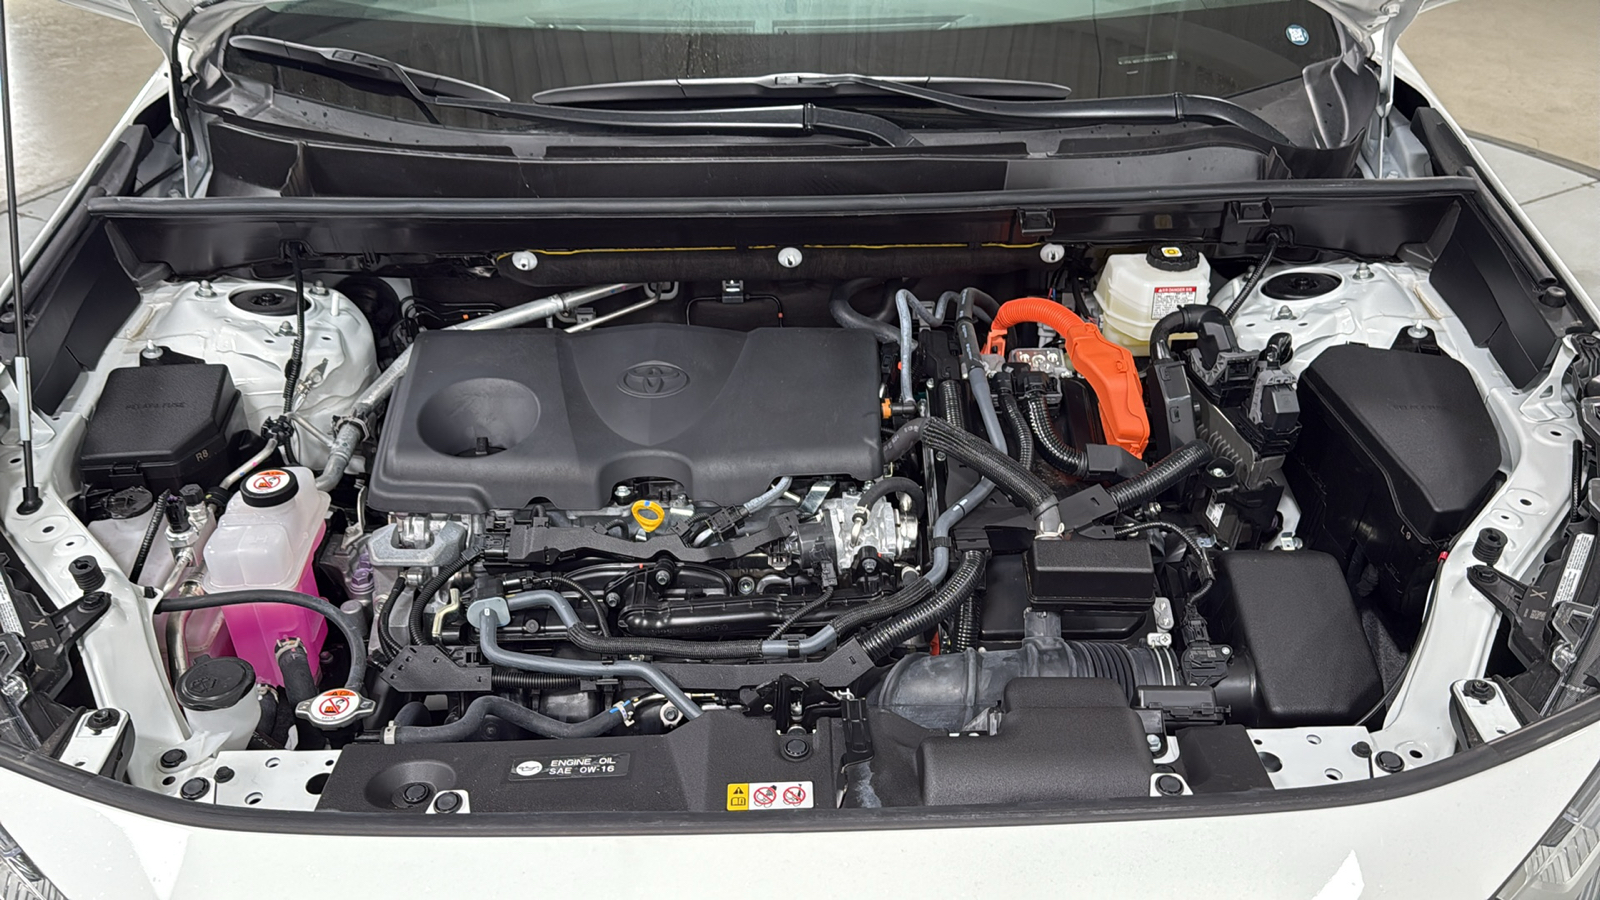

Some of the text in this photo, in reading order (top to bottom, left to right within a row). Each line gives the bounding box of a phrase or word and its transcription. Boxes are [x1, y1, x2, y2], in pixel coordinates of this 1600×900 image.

[195, 449, 208, 462] R8
[1400, 524, 1412, 540] L9
[550, 758, 592, 767] ENGINE
[548, 767, 573, 775] SAE
